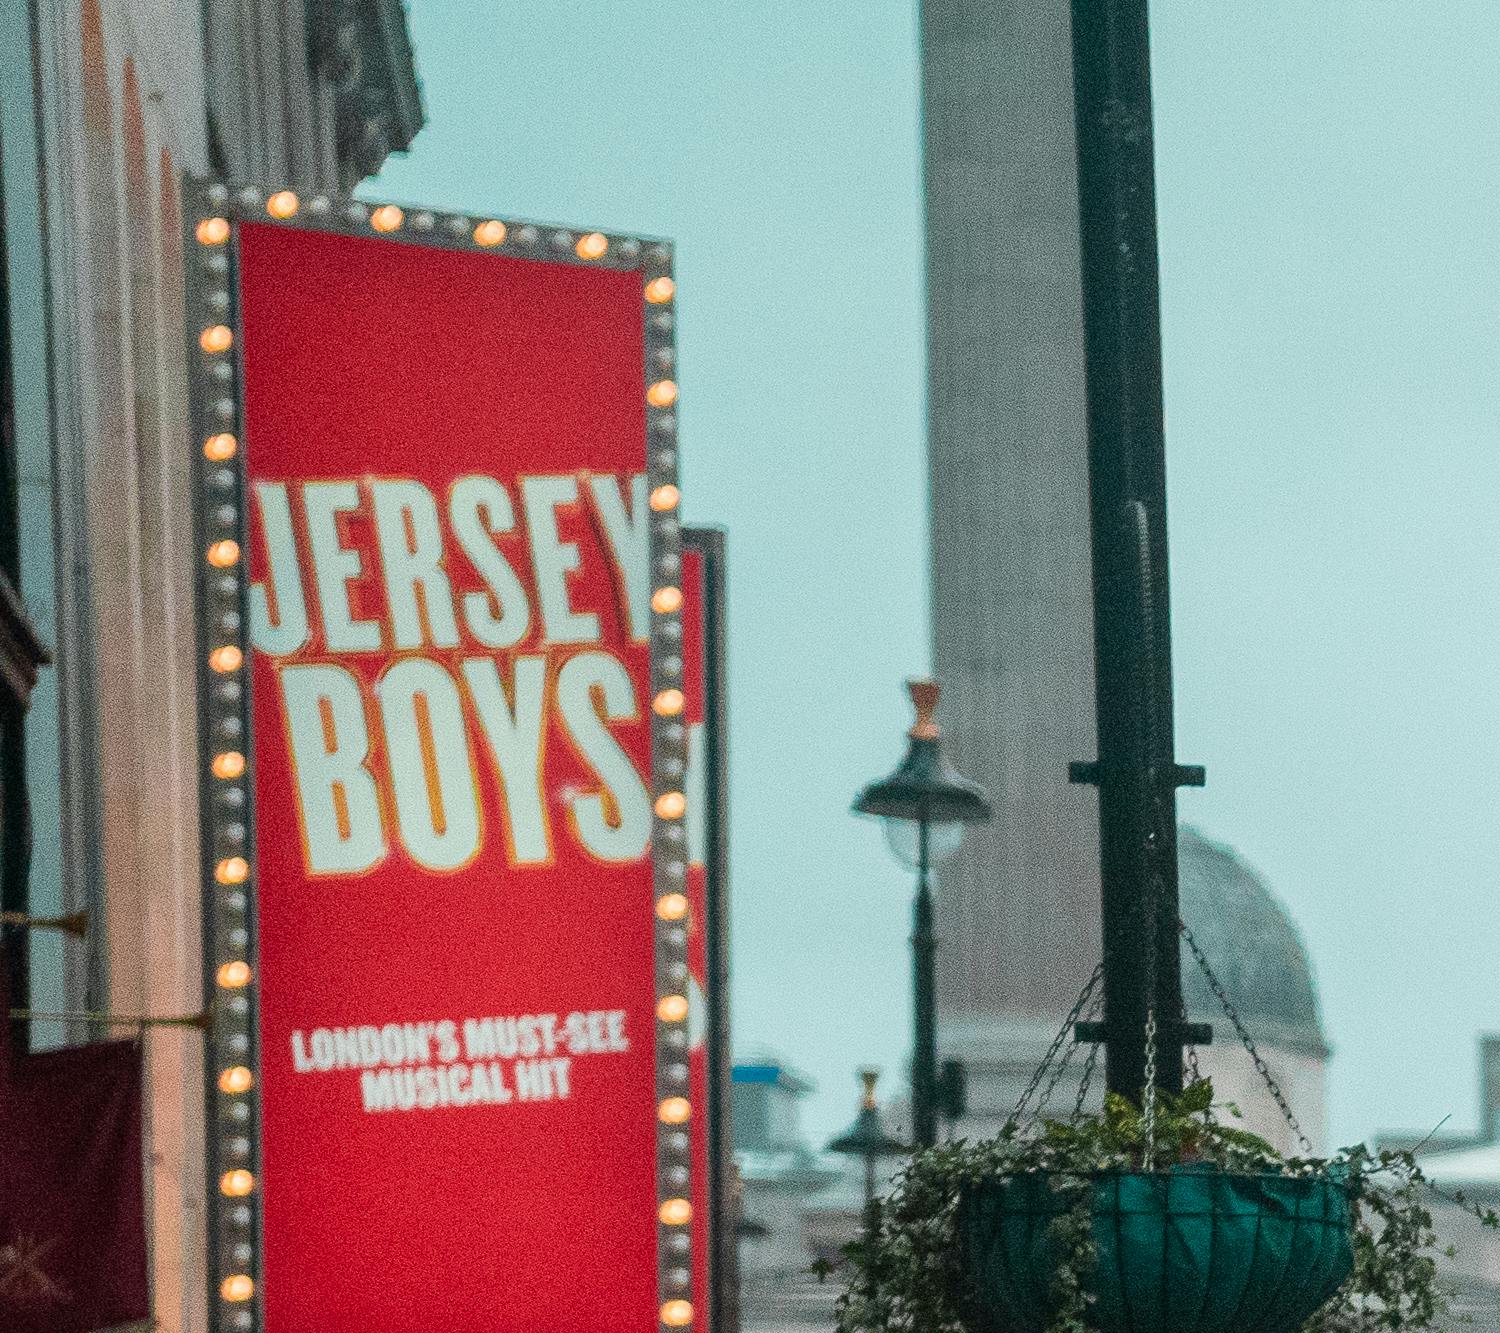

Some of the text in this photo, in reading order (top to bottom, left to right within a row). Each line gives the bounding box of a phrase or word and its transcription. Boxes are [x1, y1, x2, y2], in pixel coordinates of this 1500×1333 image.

[247, 472, 651, 657] JERSEY
[279, 651, 653, 878] BOYS
[290, 1009, 629, 1073] LONDON'S MUST-SEE
[360, 1056, 573, 1113] MUSICAL HIT
